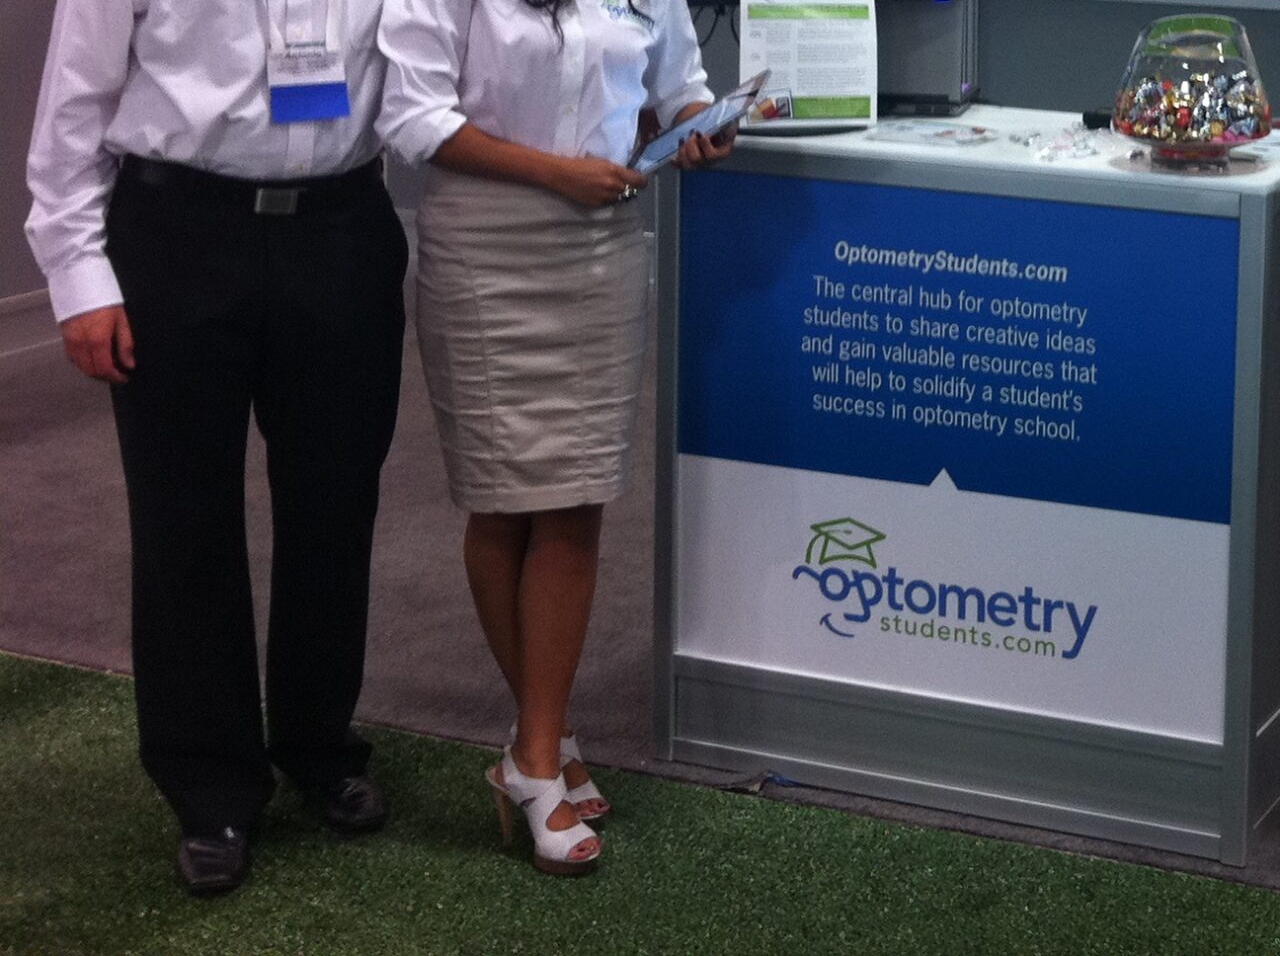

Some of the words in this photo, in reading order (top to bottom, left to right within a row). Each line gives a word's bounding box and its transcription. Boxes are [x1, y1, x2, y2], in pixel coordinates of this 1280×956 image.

[834, 241, 1068, 283] OptometryStudents.com
[813, 275, 845, 299] The
[851, 280, 913, 306] central
[919, 287, 951, 311] hub
[958, 290, 984, 313] for
[991, 295, 1088, 328] optometry
[803, 305, 879, 332] students
[886, 312, 902, 334] to
[910, 315, 959, 341] share
[966, 323, 1039, 349] creative
[1045, 330, 1096, 356] ideas
[801, 333, 832, 355] and
[839, 338, 875, 362] gain
[882, 342, 955, 369] valuable
[962, 353, 1054, 380] resources
[1061, 360, 1098, 386] that
[812, 362, 839, 384] will
[845, 364, 882, 391] help
[888, 370, 906, 392] to
[913, 373, 975, 404] solidify
[982, 384, 993, 402] a
[1000, 384, 1083, 413] student's
[812, 393, 885, 419] success
[891, 398, 906, 421] in
[913, 402, 1007, 437] optometry
[1014, 415, 1080, 442] school.
[818, 567, 1098, 660] optometry
[880, 615, 1056, 657] students.com
